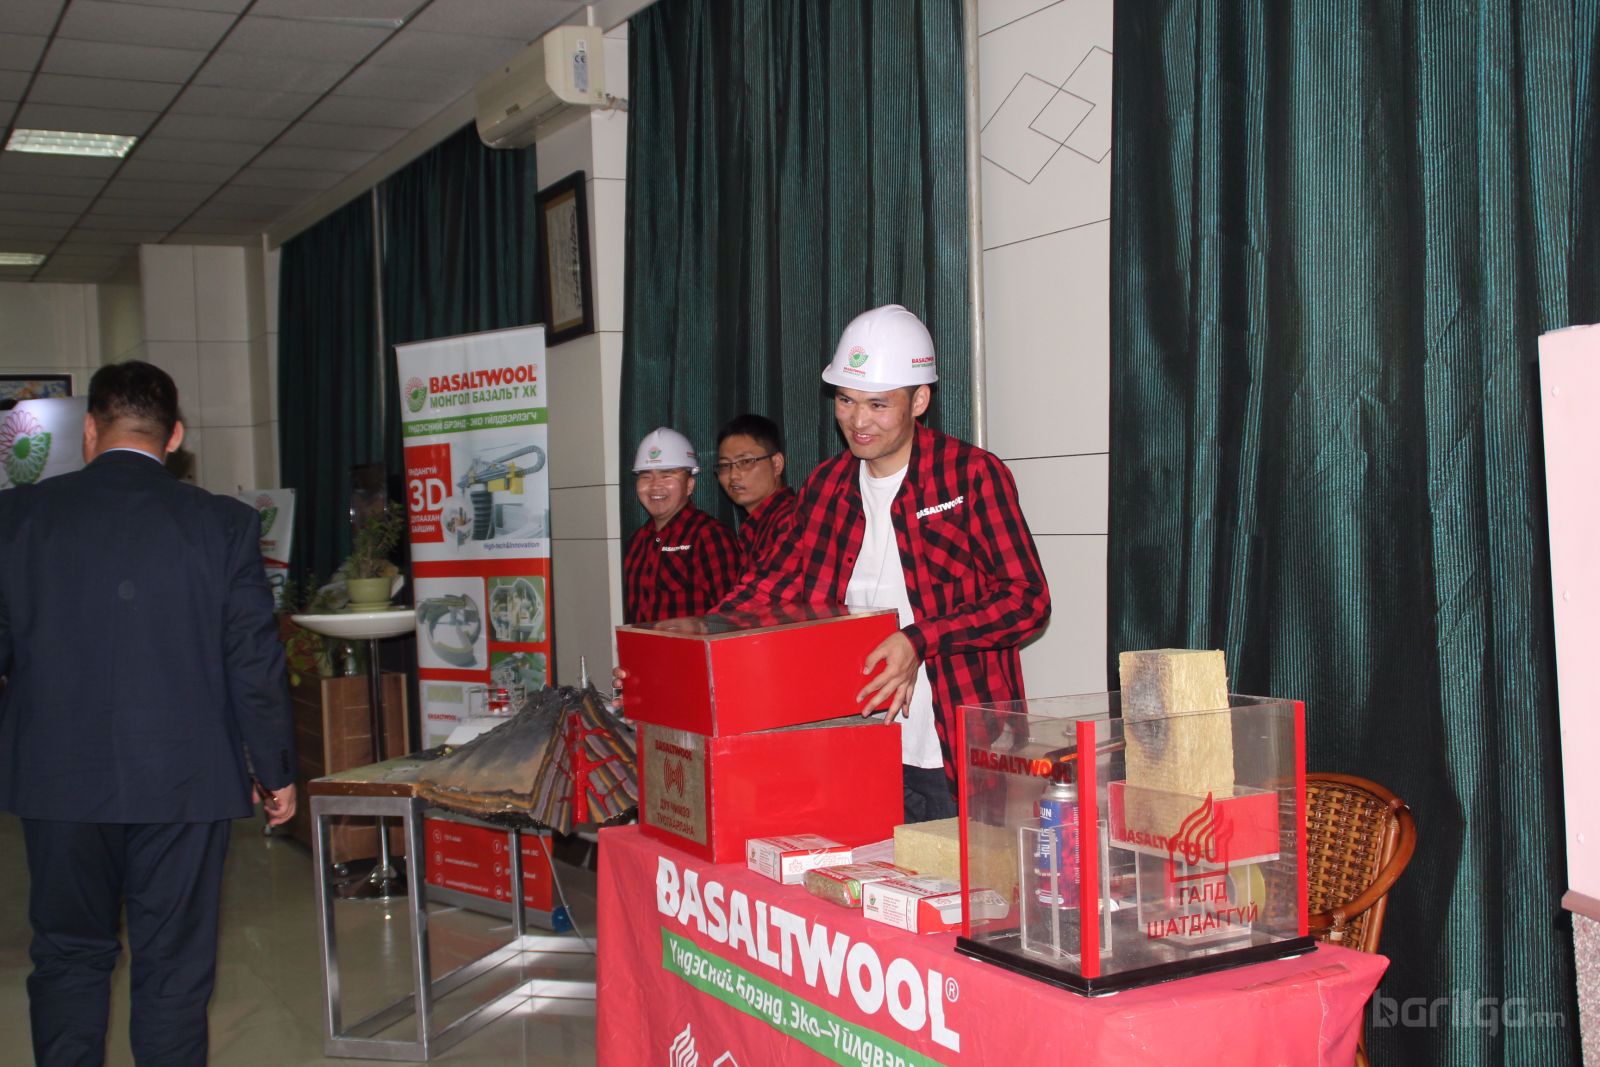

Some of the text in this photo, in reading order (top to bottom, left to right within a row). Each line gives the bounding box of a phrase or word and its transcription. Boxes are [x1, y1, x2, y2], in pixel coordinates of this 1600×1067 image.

[429, 364, 537, 394] BASALTWOOL
[430, 384, 537, 409] МОНГОЛ БАЗАЛЬТ ХК
[409, 478, 447, 512] 3D
[1178, 881, 1228, 906] ГАЛД
